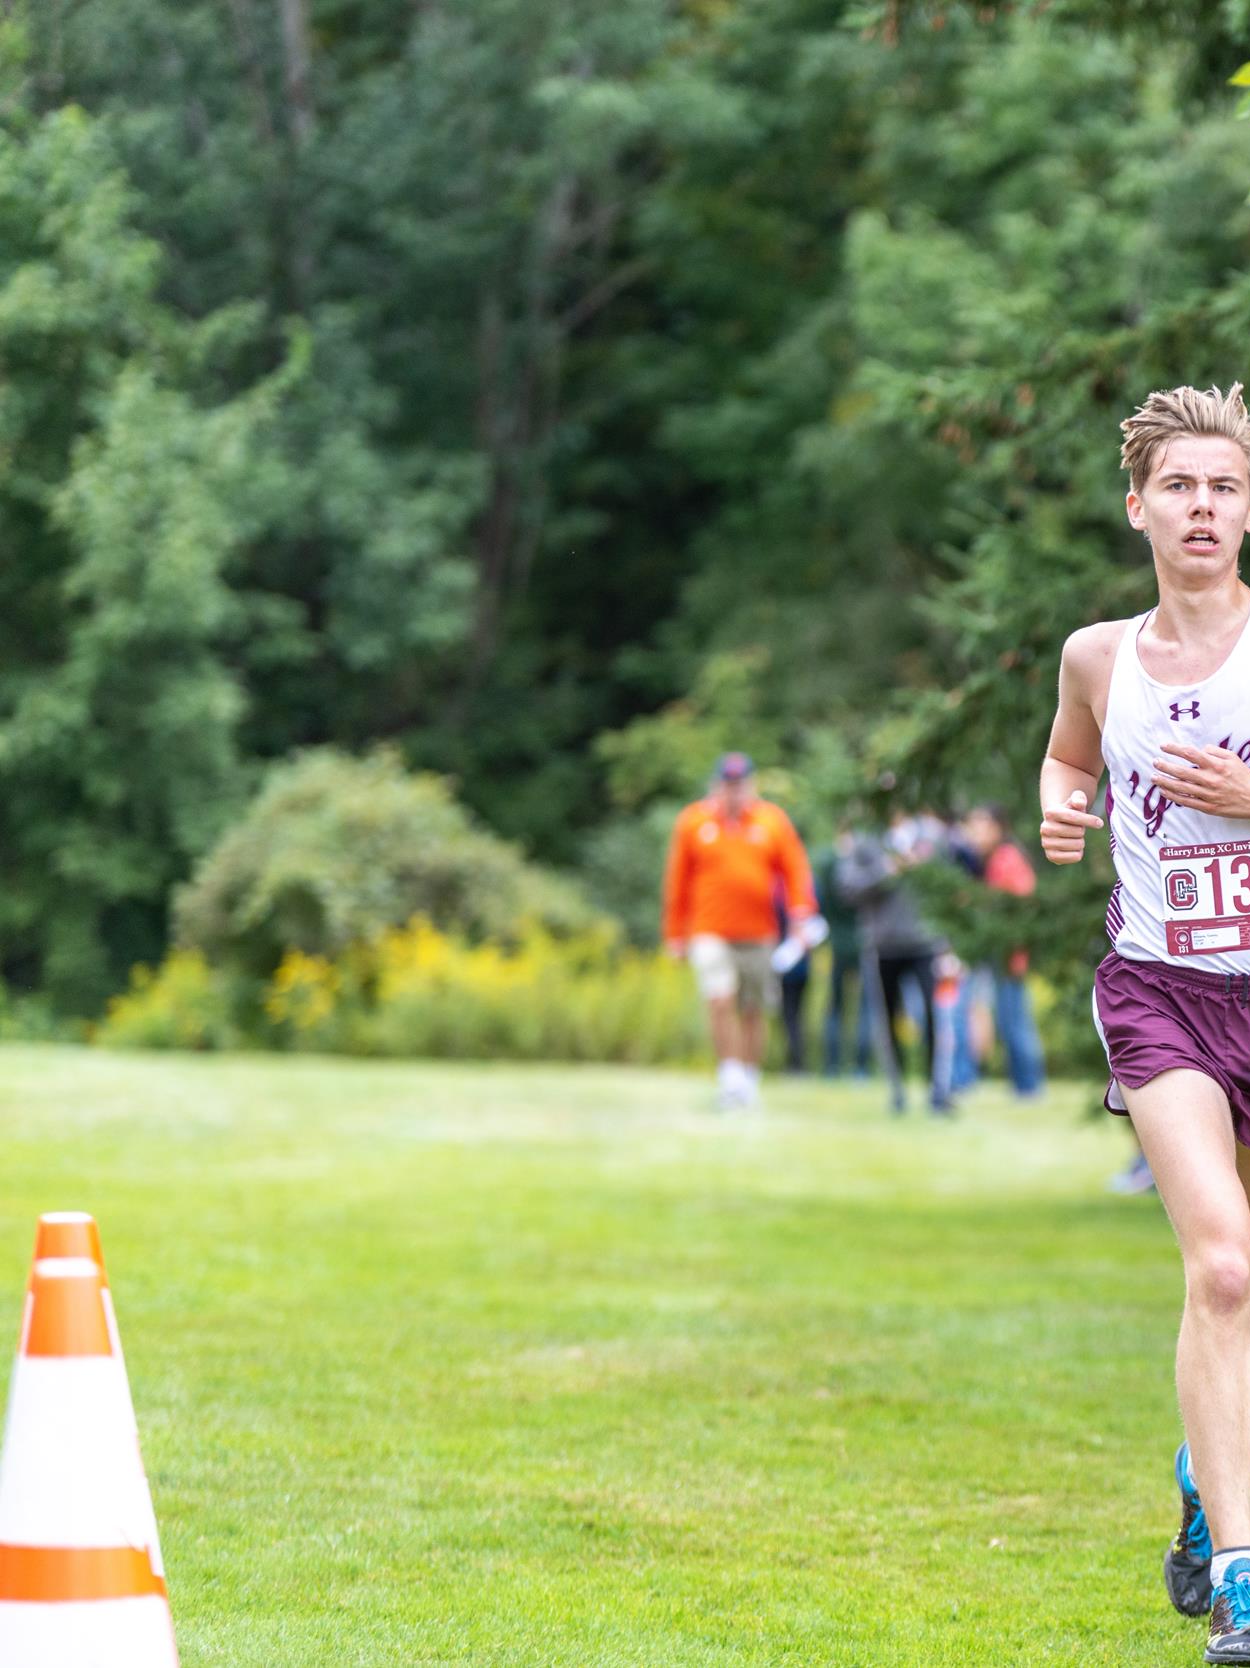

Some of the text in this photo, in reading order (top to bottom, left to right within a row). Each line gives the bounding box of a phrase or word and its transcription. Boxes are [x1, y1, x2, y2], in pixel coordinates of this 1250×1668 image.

[1167, 848, 1191, 857] Harry
[1193, 846, 1216, 856] Lang
[1217, 844, 1232, 853] XC
[1178, 945, 1189, 954] 131
